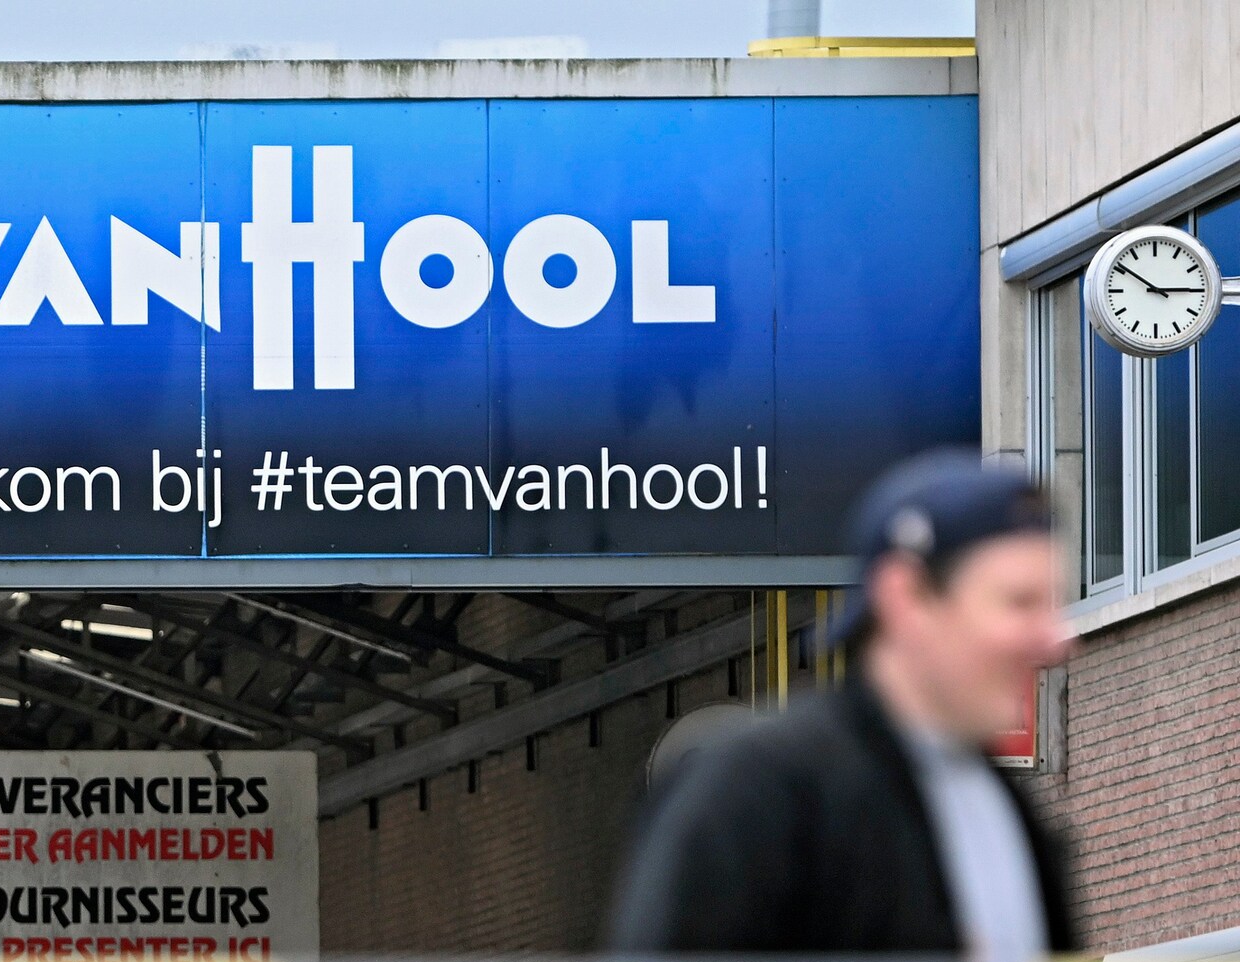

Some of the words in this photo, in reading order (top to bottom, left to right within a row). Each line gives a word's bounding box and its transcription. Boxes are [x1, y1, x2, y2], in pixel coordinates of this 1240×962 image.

[151, 448, 223, 528] bij
[250, 445, 768, 513] #teamvanhool!
[47, 827, 275, 864] AANMELDEN
